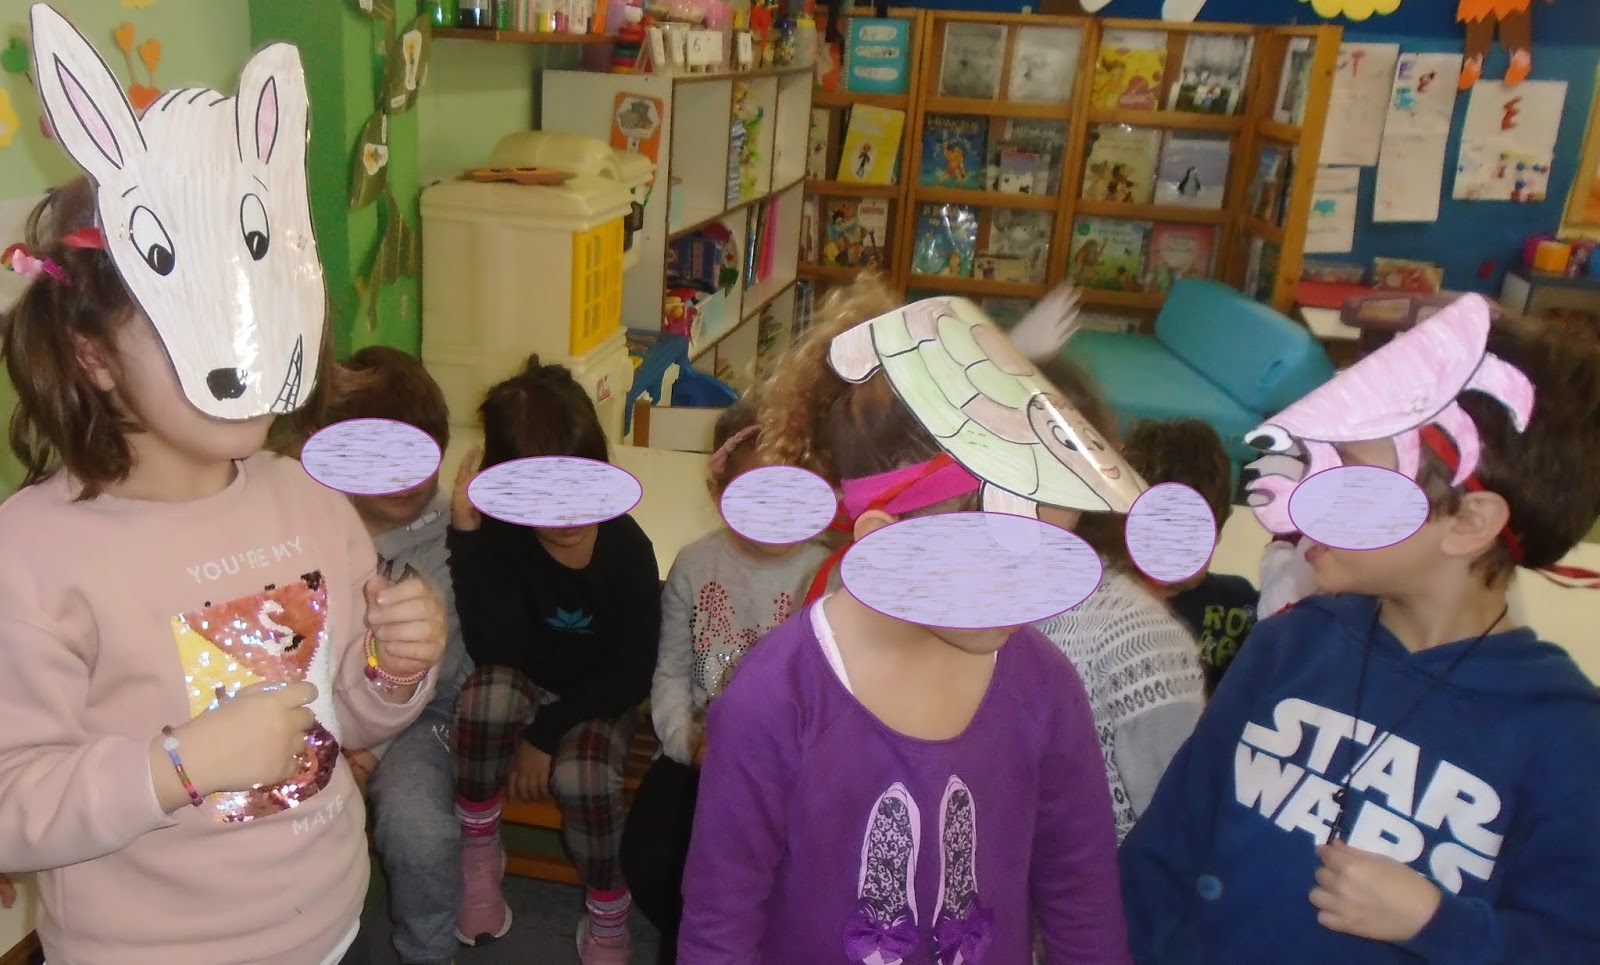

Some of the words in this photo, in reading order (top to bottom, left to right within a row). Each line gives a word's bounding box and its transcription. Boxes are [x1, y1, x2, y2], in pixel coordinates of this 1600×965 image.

[186, 548, 270, 584] YOU'RE
[271, 535, 303, 562] MY
[291, 794, 344, 836] MATE
[1234, 740, 1496, 895] WARS
[1239, 698, 1504, 858] STAR
